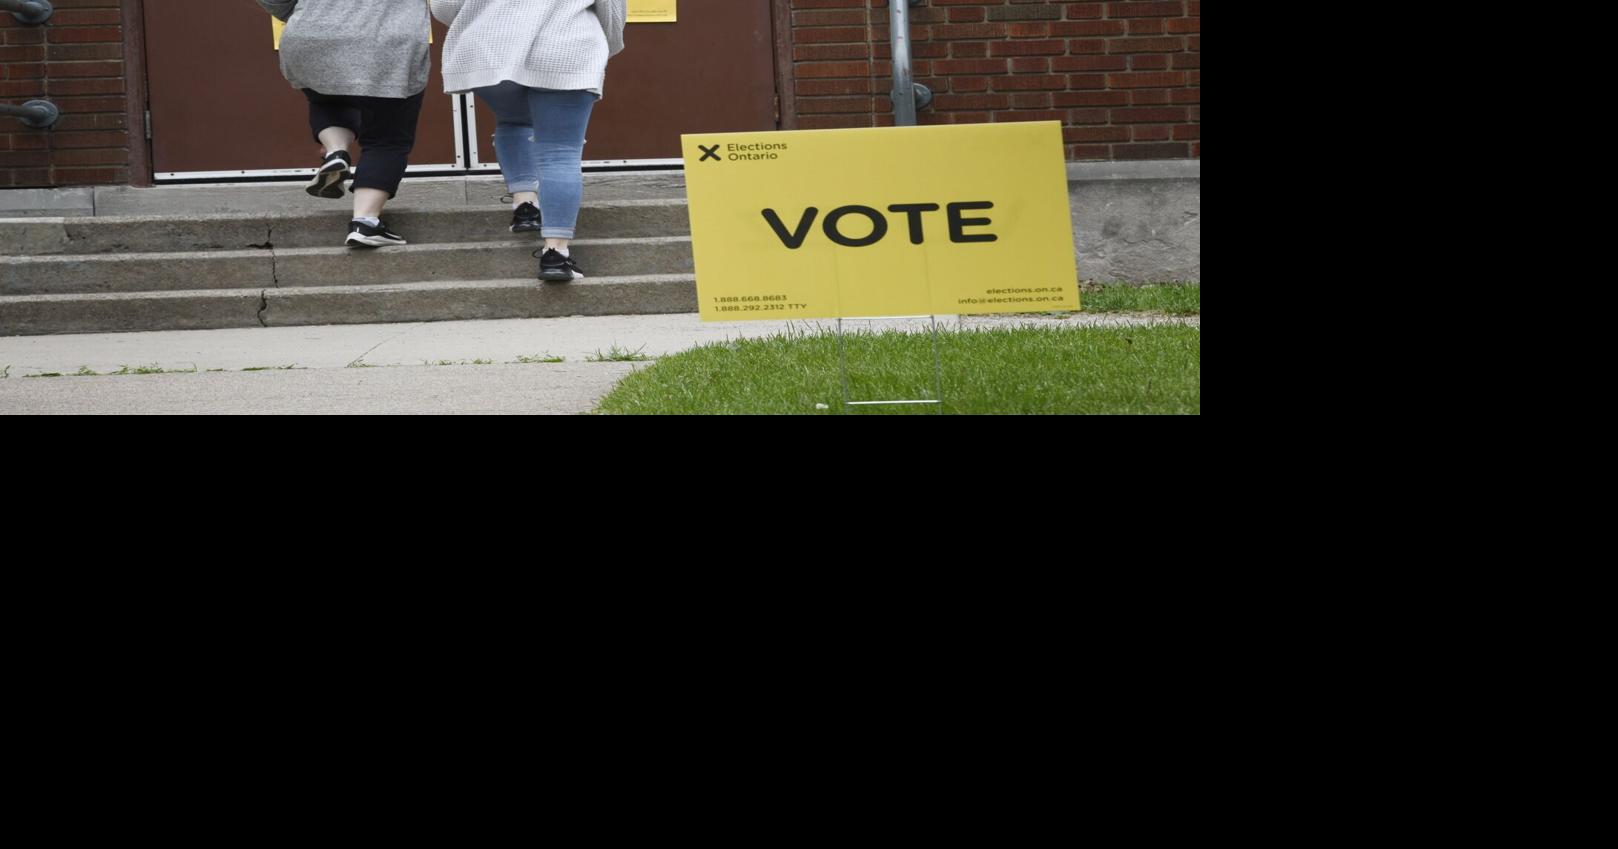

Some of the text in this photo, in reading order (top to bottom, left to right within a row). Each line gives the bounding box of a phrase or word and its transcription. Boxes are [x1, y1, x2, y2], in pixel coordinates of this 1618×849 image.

[727, 142, 788, 152] Elections
[728, 152, 778, 161] Ontario
[761, 201, 998, 249] VOTE
[986, 287, 1063, 295] elections.on.ca
[713, 294, 788, 303] 1.888.668.8683
[958, 296, 1064, 305] info@elections.on.ca
[714, 304, 785, 313] 1.888.292.2312
